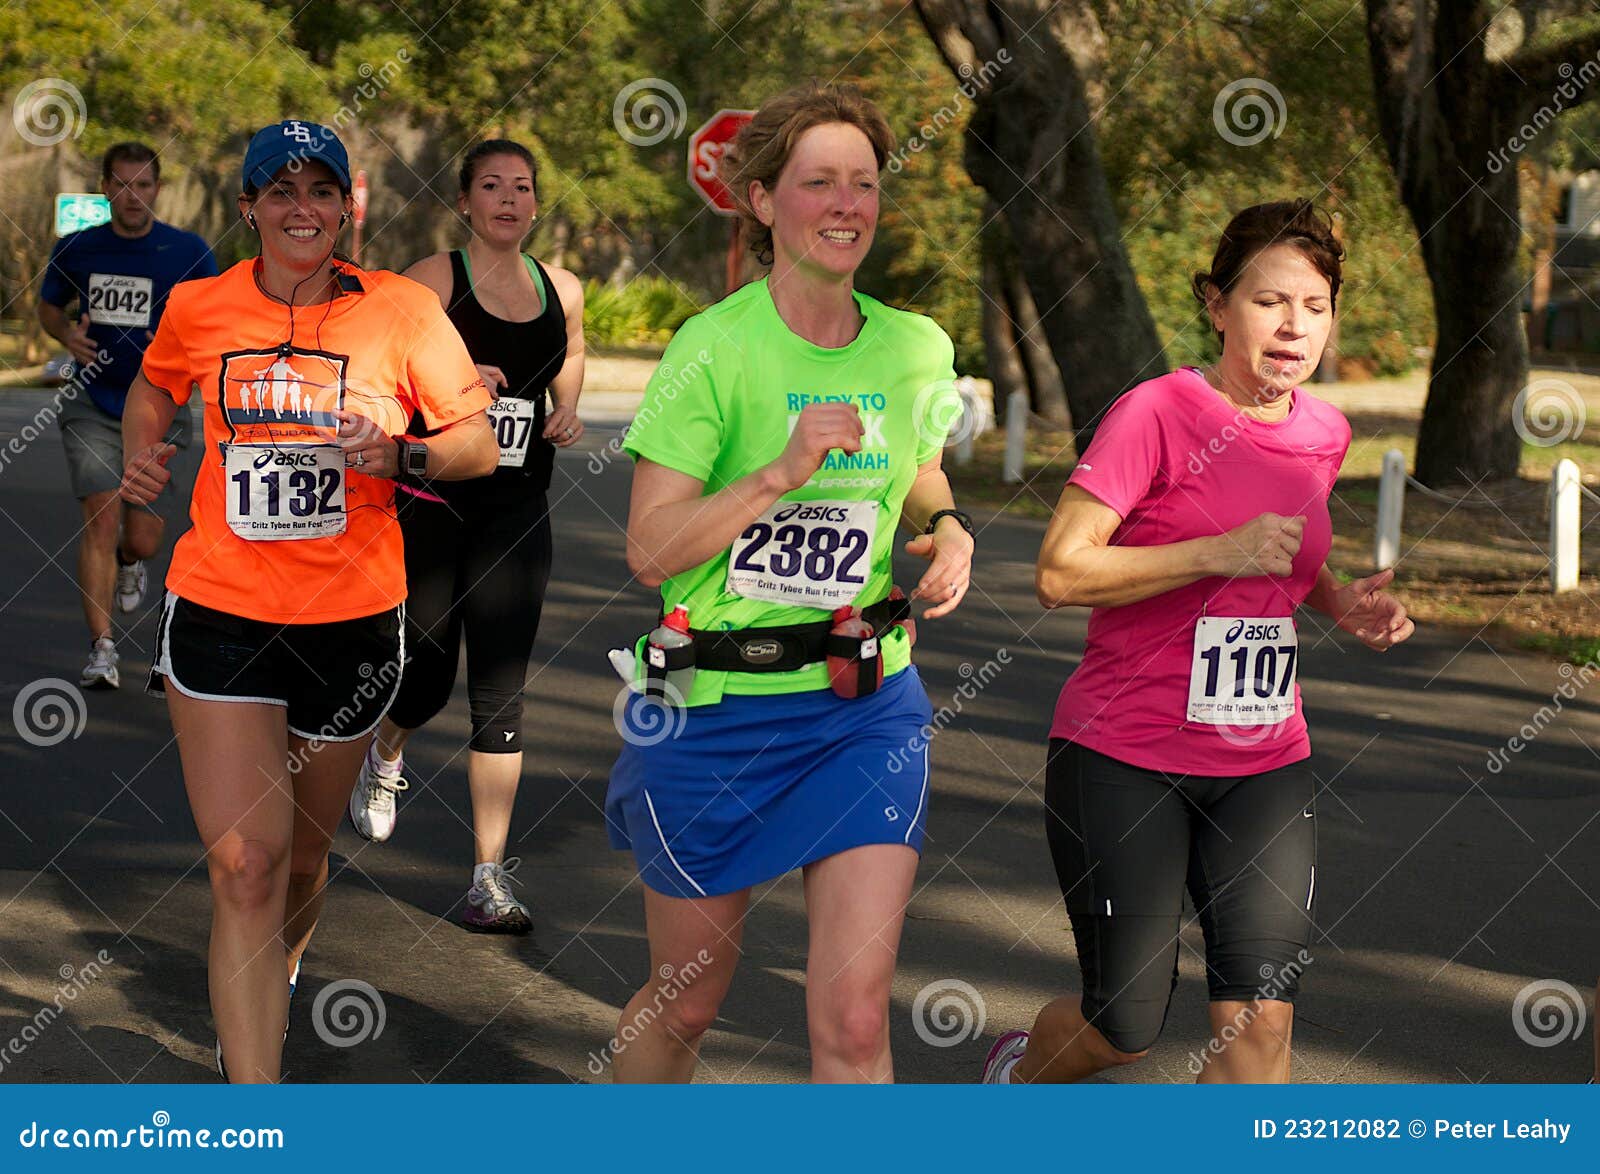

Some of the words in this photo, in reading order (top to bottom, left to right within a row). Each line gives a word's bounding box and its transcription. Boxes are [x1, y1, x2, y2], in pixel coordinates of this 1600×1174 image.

[90, 286, 149, 314] 2042
[490, 401, 517, 412] asics
[858, 393, 886, 411] TO
[487, 414, 532, 449] 07
[274, 452, 317, 466] asics
[824, 452, 889, 470] ANNAH
[232, 468, 342, 517] 1132
[798, 506, 848, 522] asics
[251, 521, 268, 529] Critz
[271, 521, 291, 531] Tybee
[293, 521, 306, 529] Run
[308, 520, 323, 528] Fest
[734, 523, 869, 584] 2382
[757, 579, 777, 591] Critz
[779, 582, 802, 594] Tybee
[805, 586, 820, 596] Run
[823, 588, 839, 598] Fest
[1244, 624, 1280, 640] asics
[1201, 646, 1297, 698] 1107
[1217, 703, 1233, 712] Critz
[1235, 703, 1252, 713] Tybee
[1267, 703, 1279, 712] Fest
